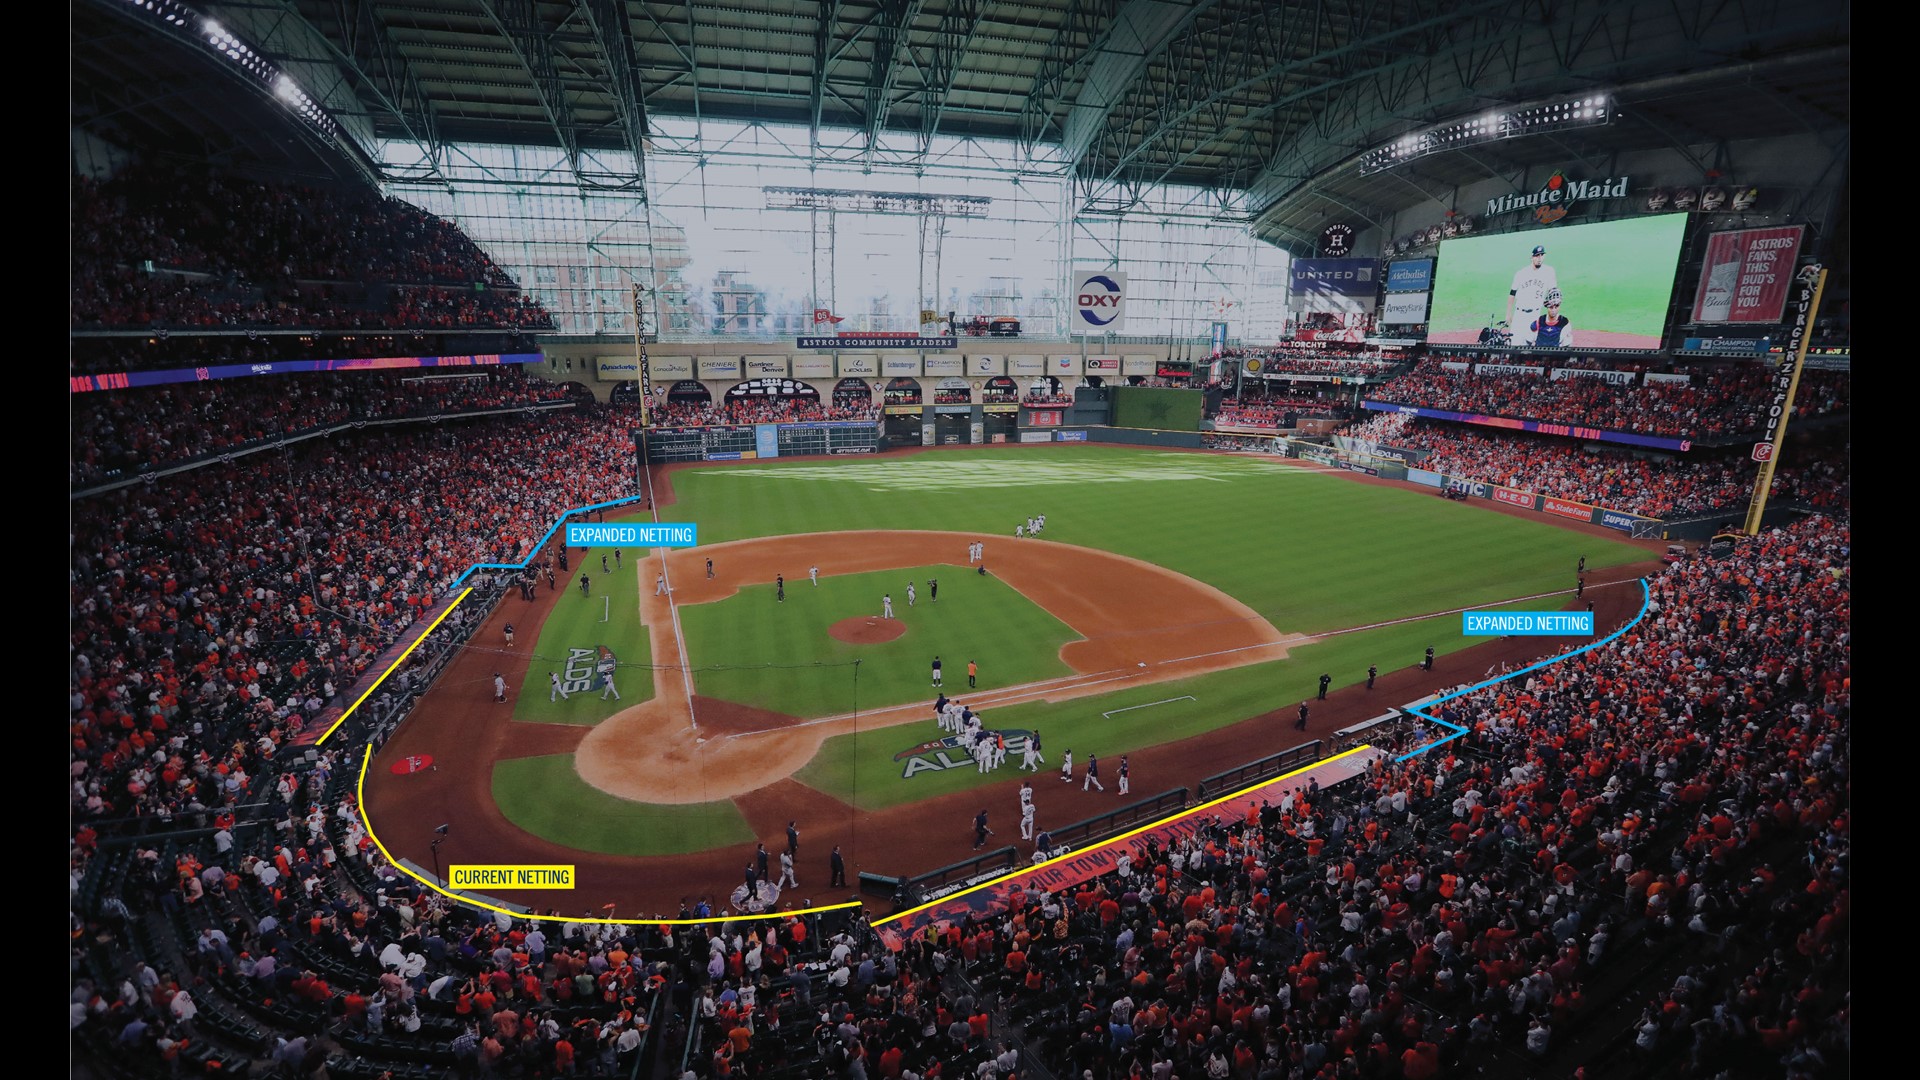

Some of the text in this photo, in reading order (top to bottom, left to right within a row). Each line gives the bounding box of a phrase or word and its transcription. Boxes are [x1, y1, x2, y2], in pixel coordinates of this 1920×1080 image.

[1485, 176, 1629, 218] Minute Maid
[1330, 234, 1344, 246] H
[1749, 237, 1794, 250] ASTROS
[1325, 247, 1348, 256] ASTROS
[1747, 250, 1778, 262] FANS,
[1746, 263, 1770, 273] THIS
[1297, 271, 1354, 280] UNITED
[1391, 269, 1427, 280] Methodist
[1742, 274, 1775, 285] BUD'S
[1739, 285, 1761, 296] FOR
[1078, 294, 1122, 308] OXY
[1737, 297, 1761, 307] YOU.
[1712, 339, 1756, 347] CHAMPION
[437, 354, 501, 366] ASTROS WIN!
[96, 372, 129, 390] WIN!
[1537, 424, 1601, 440] ASTROS WIN!
[1371, 448, 1403, 460] LEXUS
[562, 648, 595, 693] ALDS
[903, 735, 1031, 778] ALS
[1030, 868, 1065, 891] OUR
[1069, 953, 1078, 961] 34
